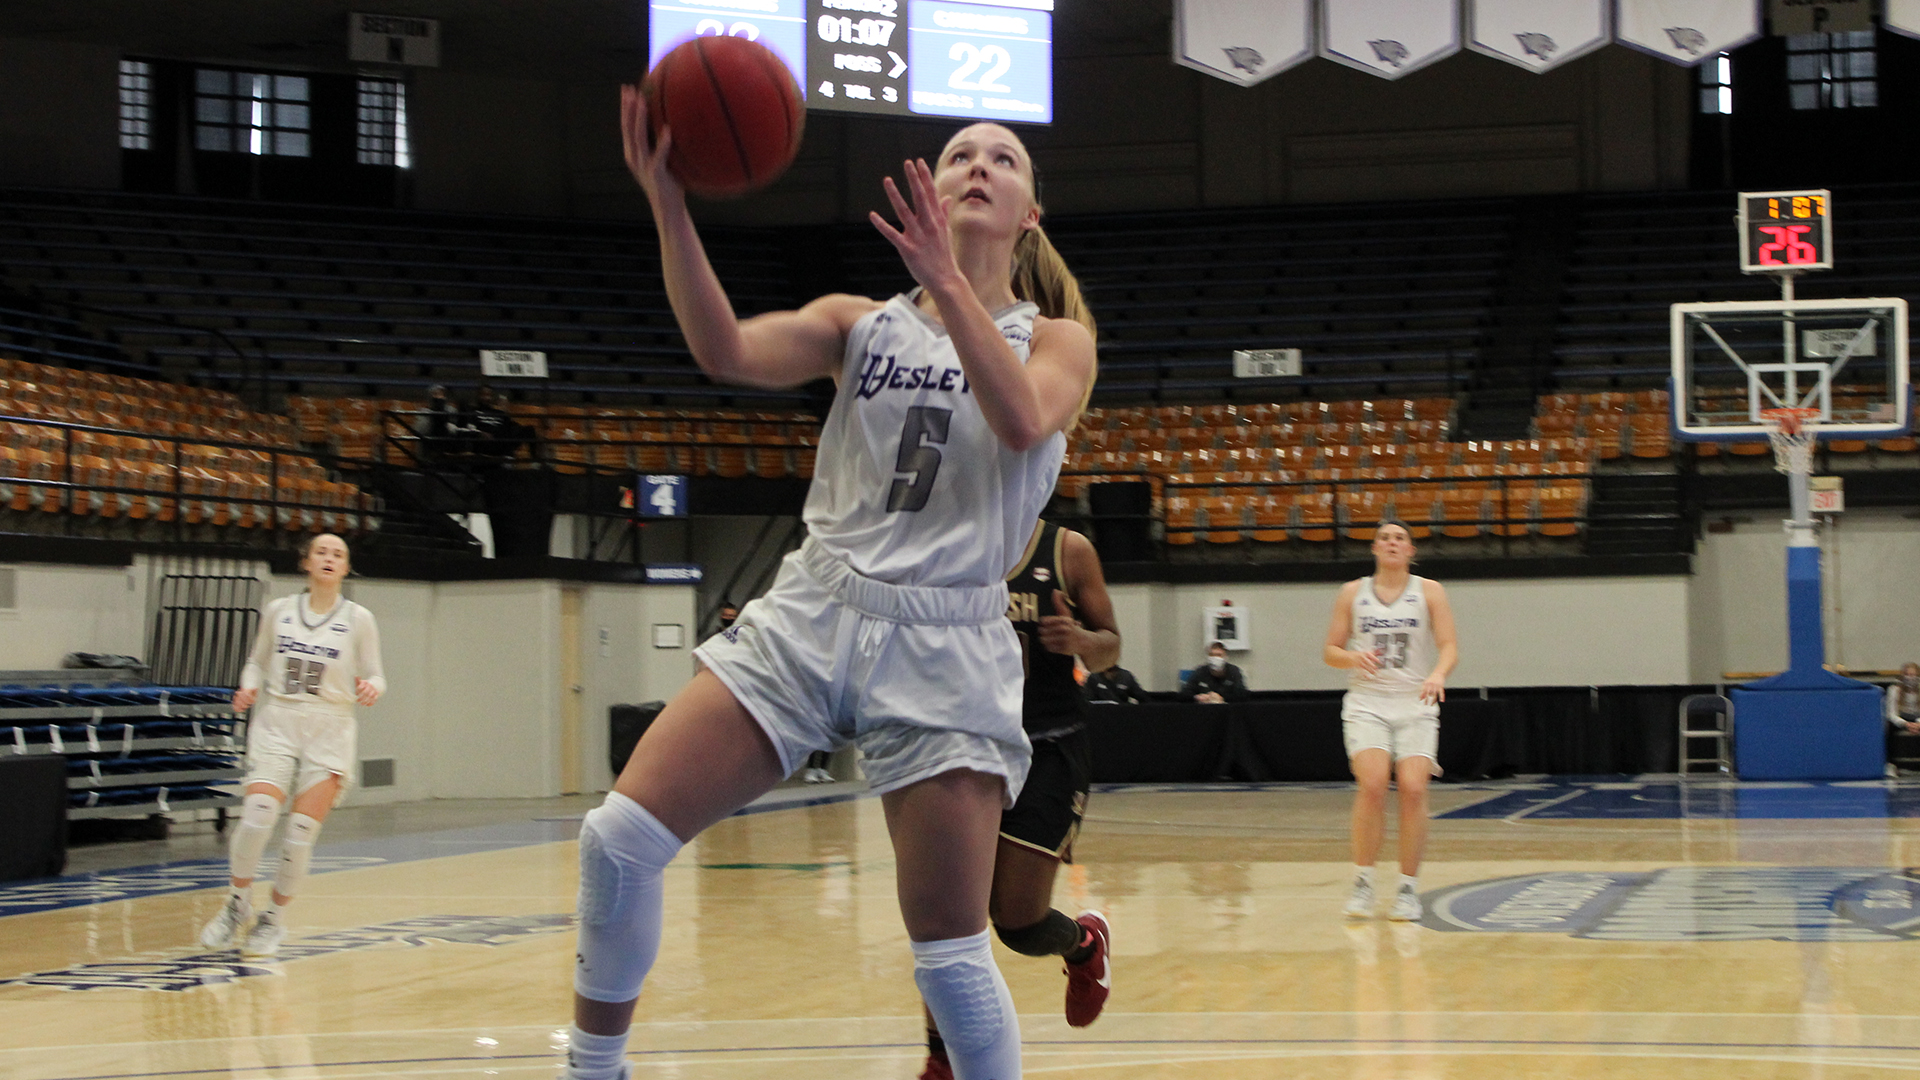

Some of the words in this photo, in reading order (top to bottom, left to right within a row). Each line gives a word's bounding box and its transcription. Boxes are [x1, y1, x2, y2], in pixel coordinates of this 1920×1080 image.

[817, 14, 897, 47] 01:07
[947, 41, 1011, 93] 22
[1758, 224, 1817, 266] 26
[886, 405, 953, 513] 5
[650, 484, 677, 515] 4
[1006, 591, 1039, 622] SH
